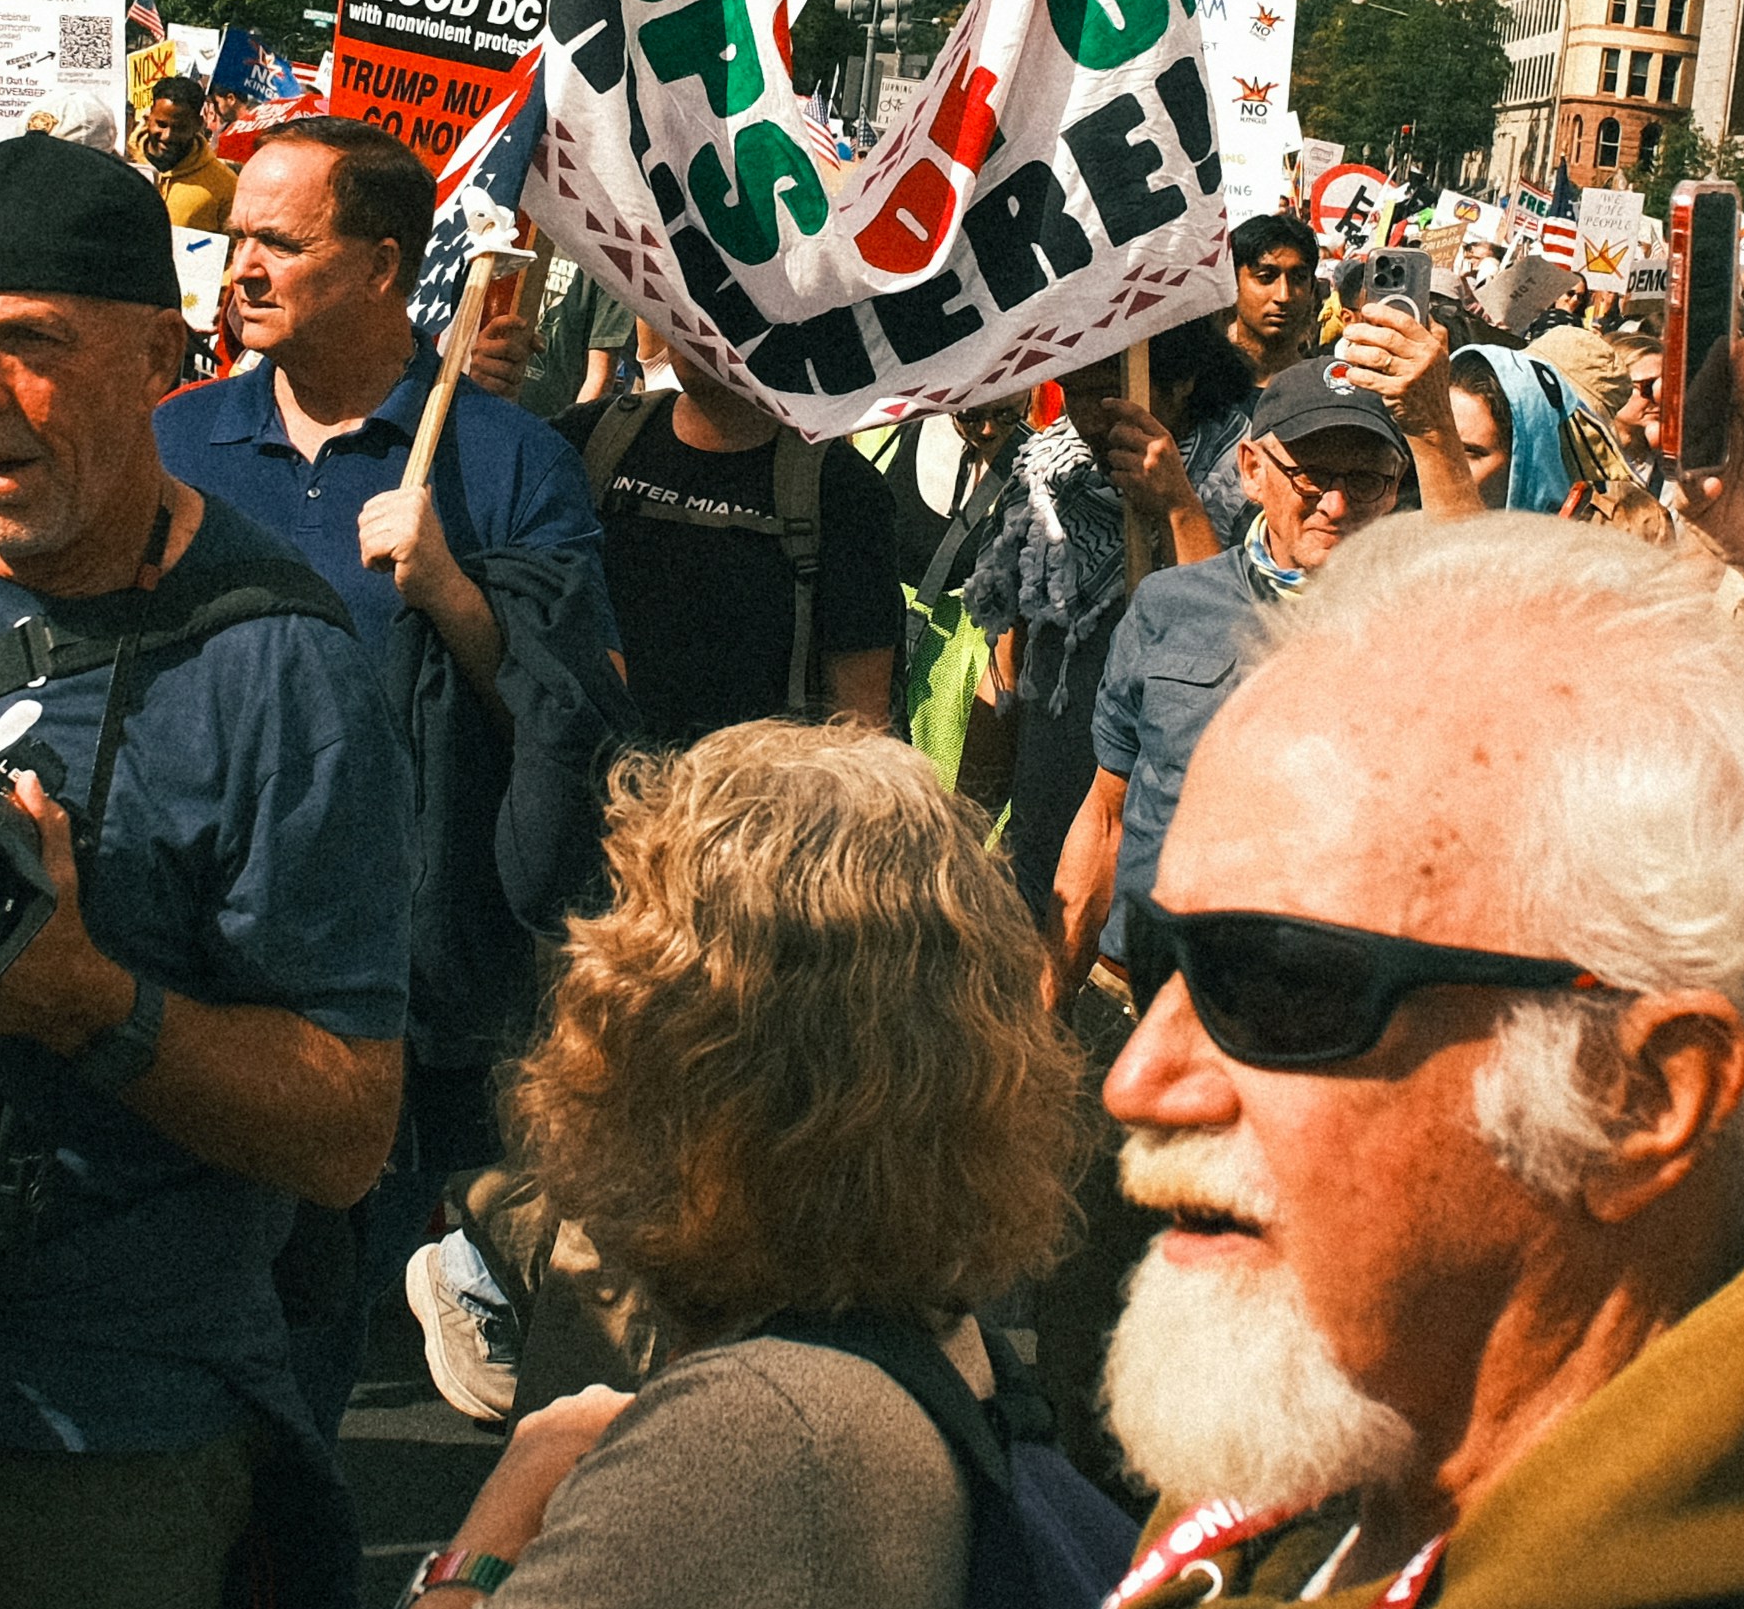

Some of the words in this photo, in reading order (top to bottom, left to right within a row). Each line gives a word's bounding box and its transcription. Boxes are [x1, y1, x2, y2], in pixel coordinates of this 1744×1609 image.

[349, 2, 382, 26] with
[385, 14, 473, 45] nonviolent
[1251, 21, 1271, 37] NO
[341, 55, 439, 107] TRUMP
[442, 78, 494, 119] MU
[882, 82, 913, 95] TURNING
[1241, 102, 1268, 117] NO
[410, 116, 471, 156] NO
[613, 475, 680, 505] INTER
